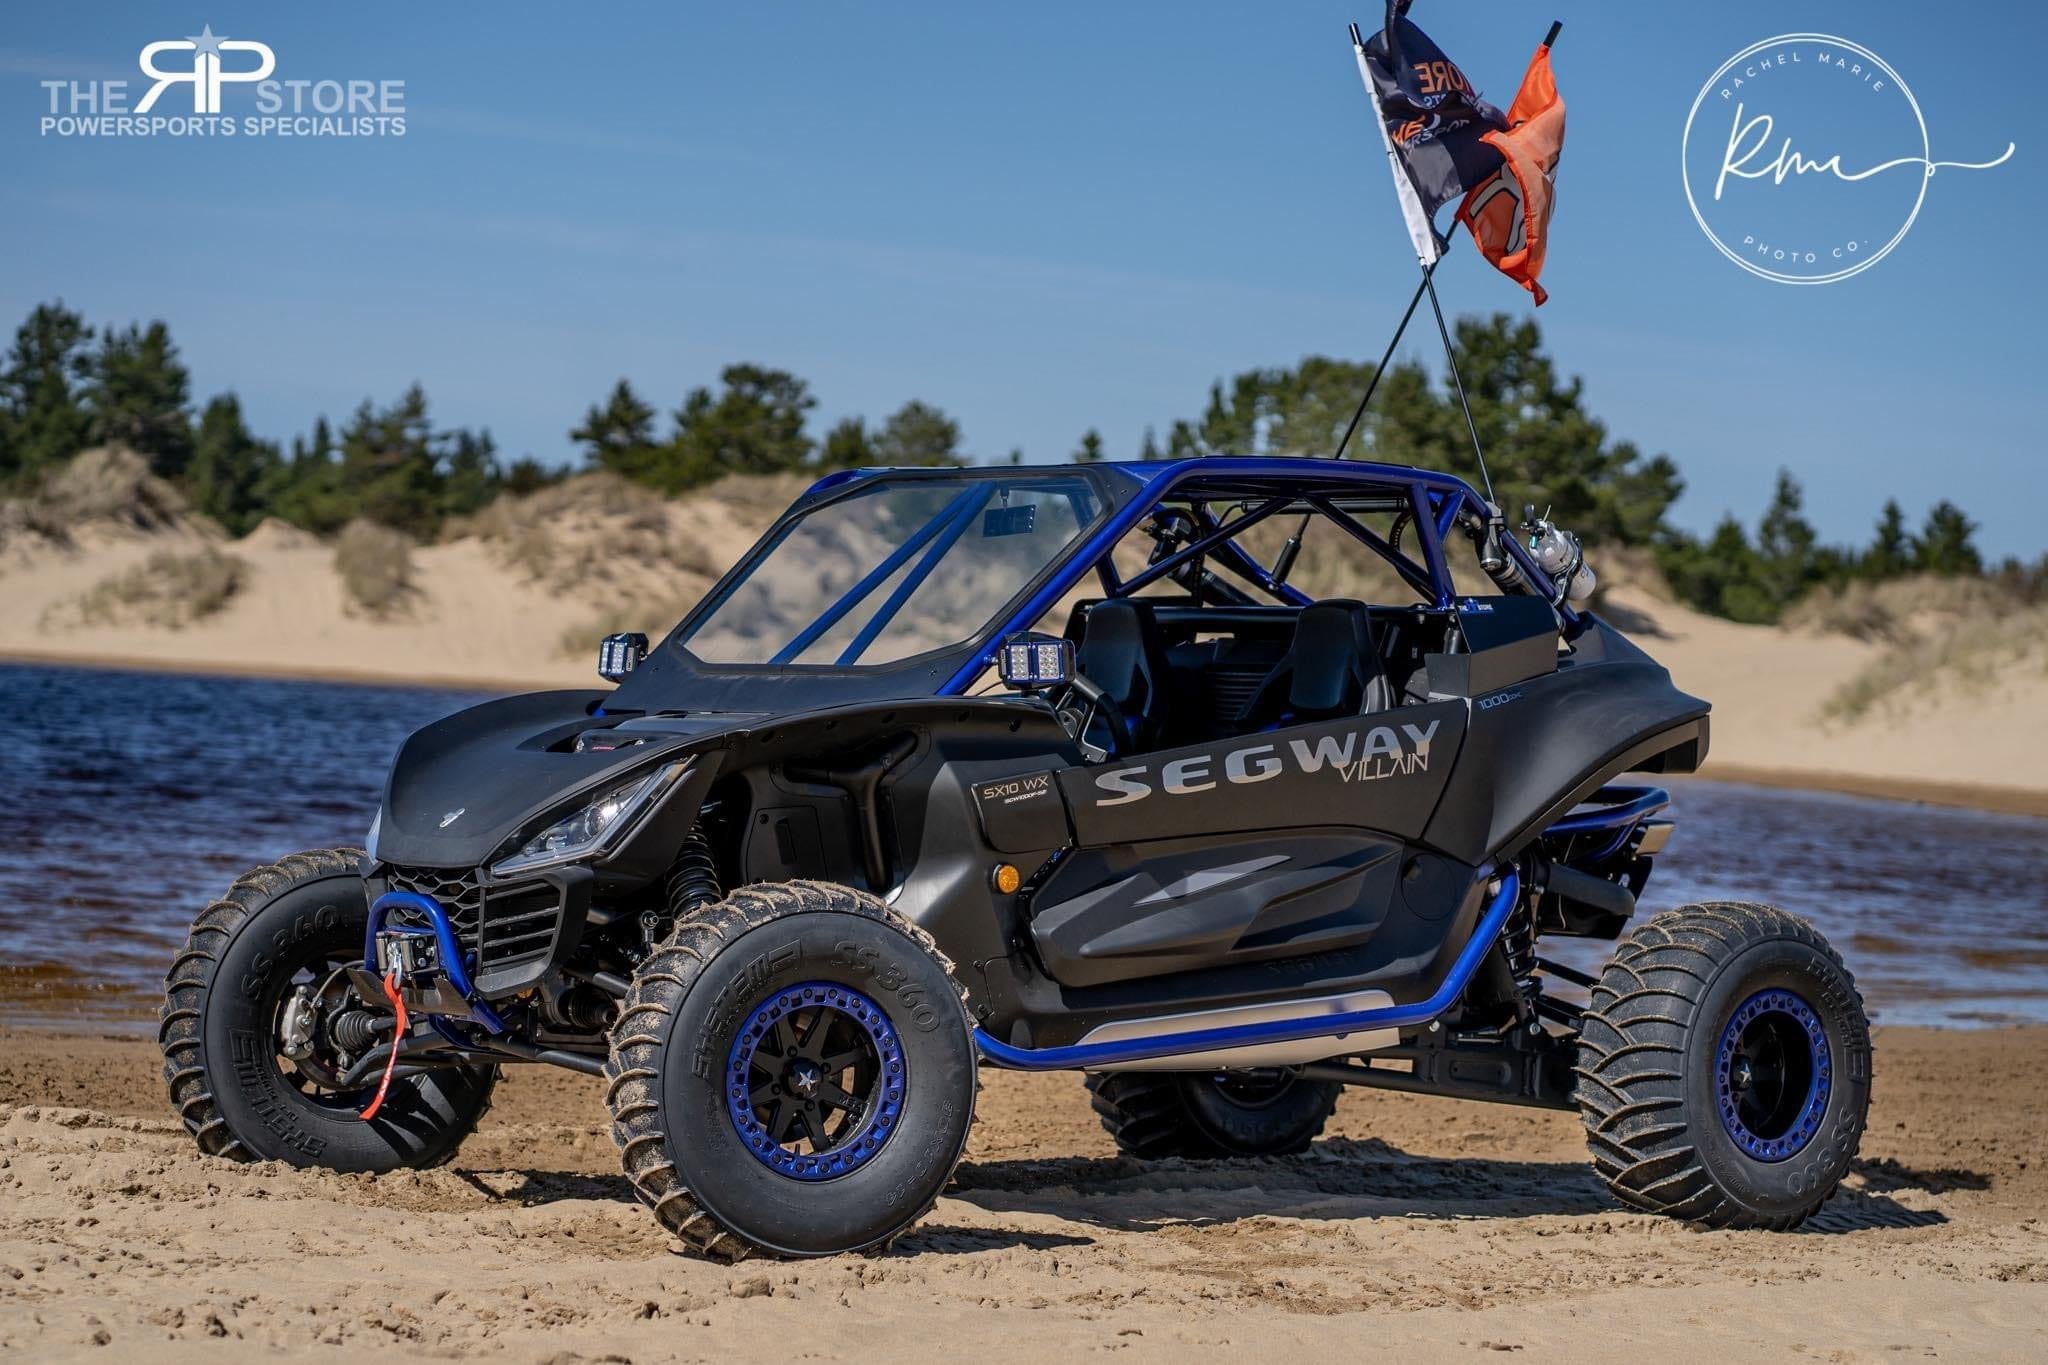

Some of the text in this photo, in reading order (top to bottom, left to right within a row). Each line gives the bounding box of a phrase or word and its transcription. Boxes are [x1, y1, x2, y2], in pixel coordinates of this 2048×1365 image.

[1094, 719, 1441, 807] SEGWAY
[1338, 751, 1429, 784] VILLAIN
[983, 774, 1049, 800] SX10 WX
